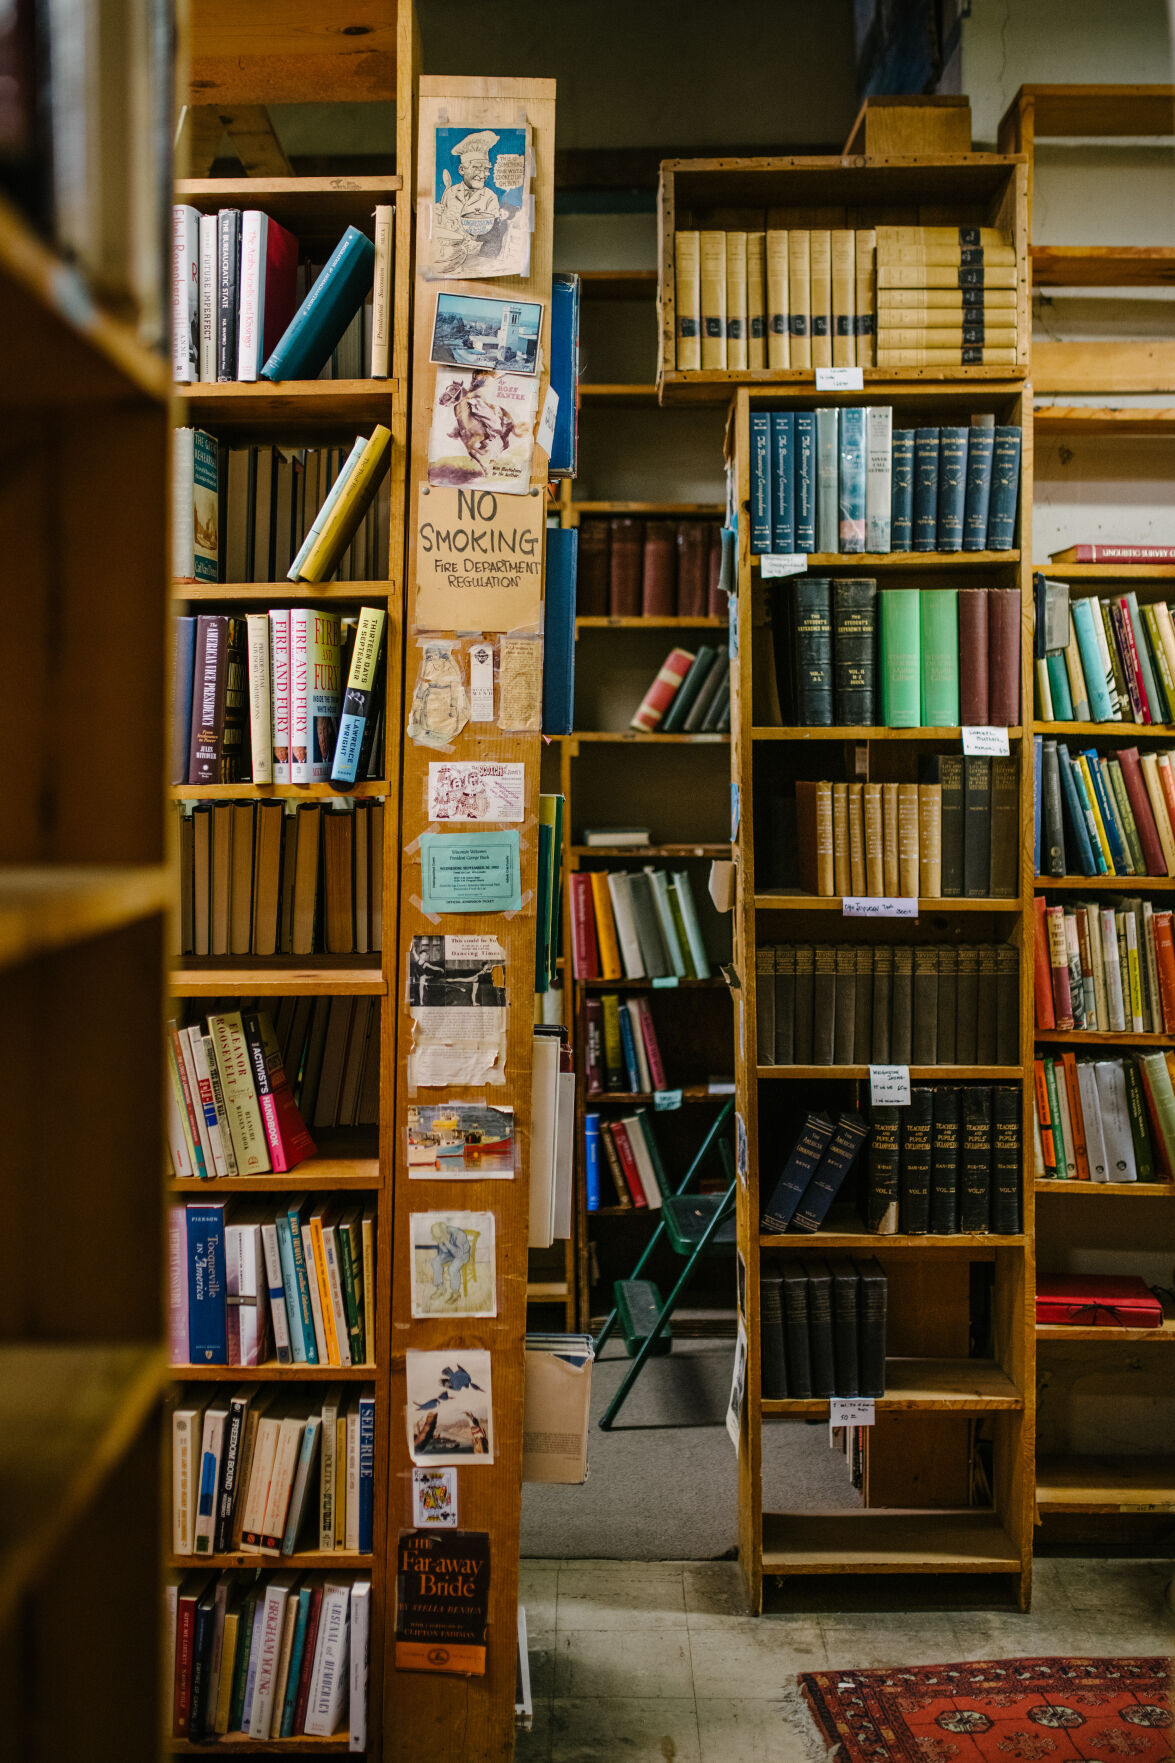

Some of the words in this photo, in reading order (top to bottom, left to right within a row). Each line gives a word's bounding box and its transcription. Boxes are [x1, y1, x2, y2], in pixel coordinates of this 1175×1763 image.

[458, 489, 498, 521] NO
[420, 522, 538, 556] SMOKING
[434, 559, 458, 572] FIRE
[464, 558, 541, 574] DEPARTMENT
[448, 574, 522, 588] REGULATION
[276, 621, 287, 655] FIRE
[296, 621, 307, 655] FIRE
[314, 618, 339, 646] FIRE
[364, 619, 369, 627] IN
[367, 619, 378, 658] THIRTEEN
[206, 627, 219, 664] AMERICAN
[322, 651, 333, 661] AND
[354, 631, 368, 680] SEPTEMBER
[204, 665, 218, 681] VICE
[276, 659, 288, 692] AND
[296, 659, 307, 692] AND
[314, 664, 340, 691] FURY
[361, 660, 370, 684] DAYS
[202, 682, 216, 727] PRESIDENCY
[277, 697, 289, 736] FURY
[296, 697, 307, 735] FURY
[340, 723, 351, 756] WRIGHT
[347, 719, 360, 764] LAWRENCE
[217, 1018, 237, 1086] ROOSEVELT
[229, 1023, 247, 1076] ELEANOR
[253, 1047, 269, 1095] ACTIVIST'S
[263, 1096, 279, 1147] HANDBOOK
[290, 1217, 299, 1236] HARRY
[196, 1244, 203, 1253] IN
[195, 1254, 207, 1300] America
[207, 1235, 220, 1298] Tocqueville
[229, 1417, 239, 1461] FREEDOM
[360, 1408, 374, 1478] SELF-RULE
[225, 1462, 234, 1490] BOUND
[402, 1550, 483, 1575] Far-away
[264, 1600, 279, 1654] BRIGHAM
[328, 1602, 343, 1643] ARSENAL
[259, 1656, 273, 1695] YOUNG
[318, 1660, 335, 1716] DEMOCRACY
